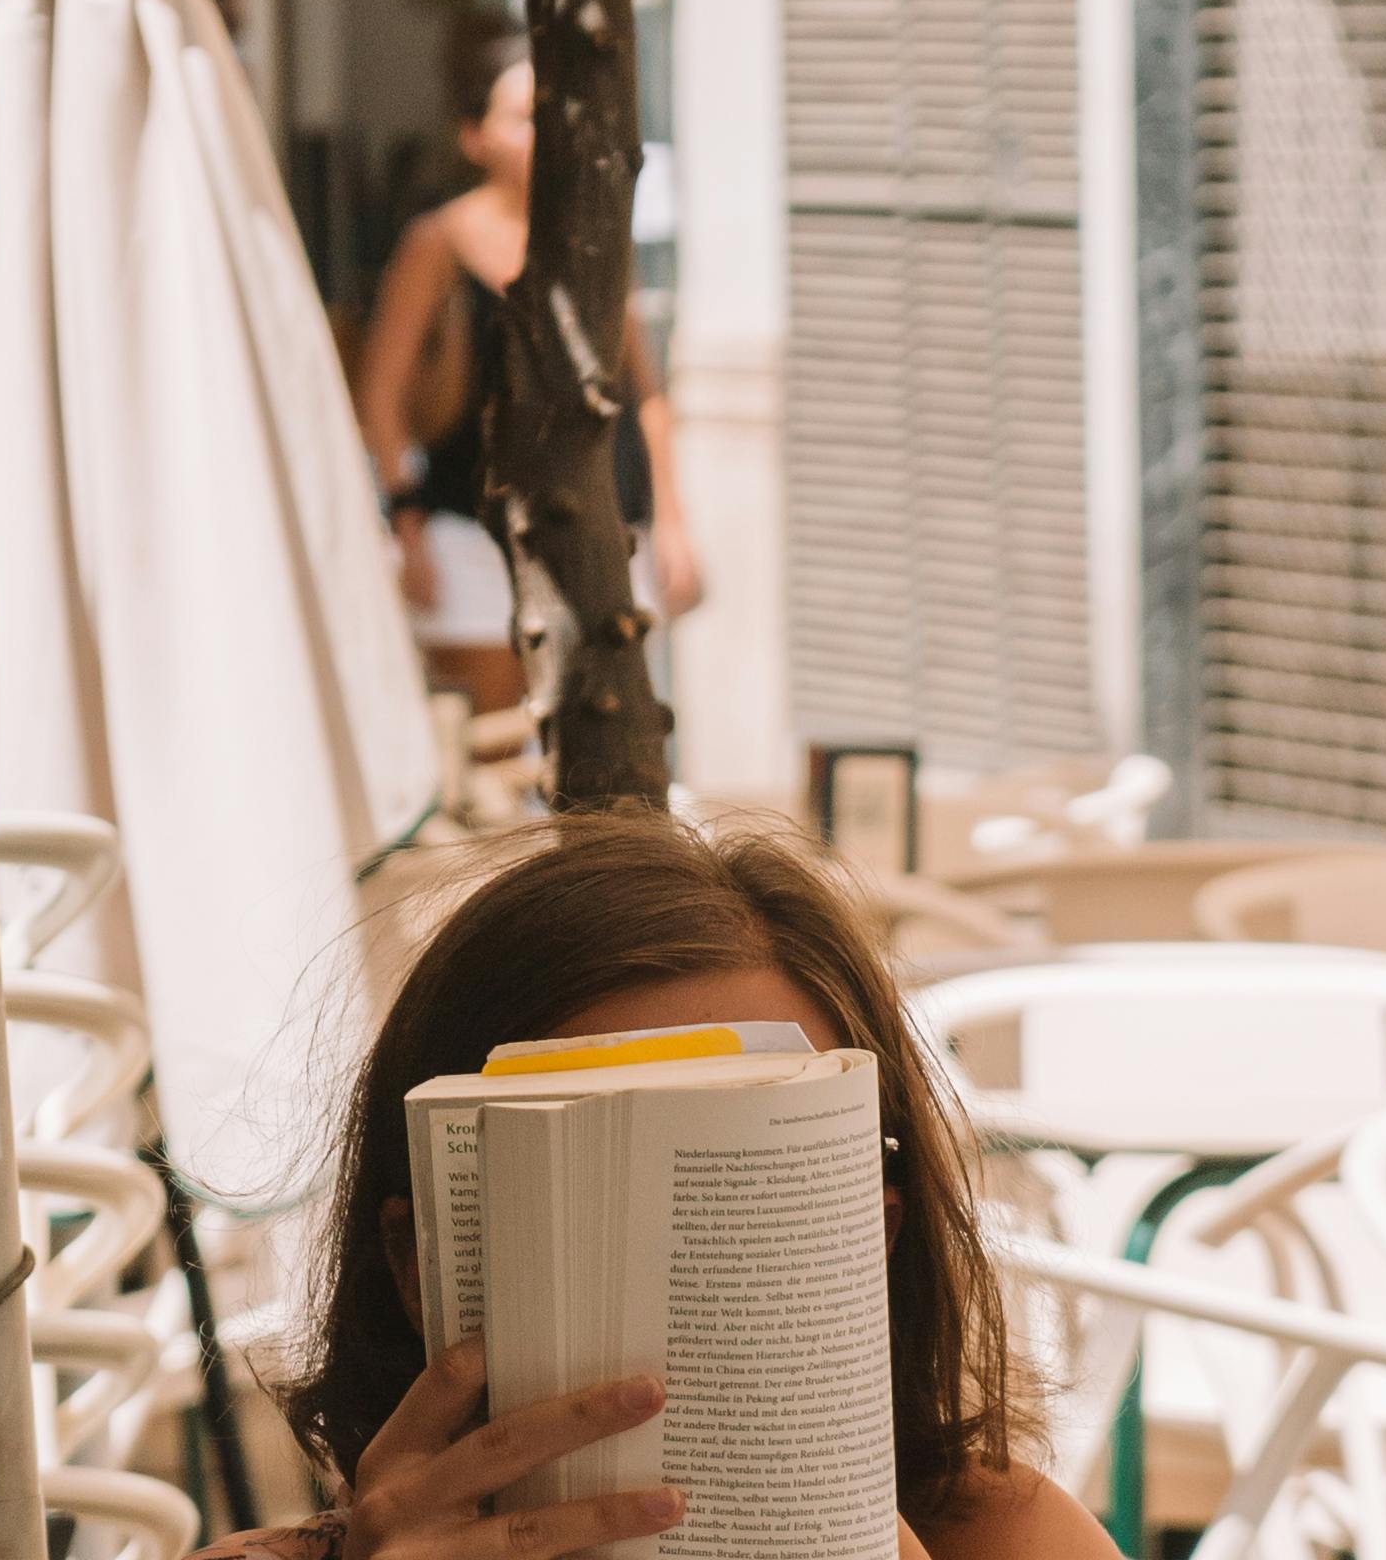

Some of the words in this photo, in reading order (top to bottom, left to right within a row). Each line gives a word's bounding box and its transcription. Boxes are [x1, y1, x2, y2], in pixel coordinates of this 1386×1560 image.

[675, 1148, 741, 1160] Niederlassung
[674, 1163, 723, 1173] finanzielle
[725, 1160, 805, 1172] Nachforschungen
[674, 1178, 689, 1187] auf
[689, 1178, 722, 1187] soziale
[723, 1177, 757, 1189] Signale
[701, 1193, 714, 1202] So
[714, 1192, 738, 1202] kann
[751, 1191, 777, 1200] sofort
[672, 1206, 688, 1216] der
[690, 1207, 709, 1216] sich
[726, 1208, 755, 1216] teures
[710, 1221, 726, 1231] der
[683, 1235, 737, 1245] Tatsächlich
[739, 1235, 772, 1246] spielen
[670, 1249, 687, 1259] der
[689, 1250, 743, 1262] Entstehung
[745, 1249, 780, 1259] sozialer
[670, 1263, 699, 1274] durch
[702, 1264, 752, 1274] erfundene
[756, 1261, 811, 1273] Hierarchien
[705, 1279, 741, 1289] Erstens
[746, 1279, 782, 1288] müssen
[669, 1293, 719, 1303] entwickelt
[765, 1292, 793, 1301] Selbst
[669, 1306, 698, 1316] Talent
[720, 1307, 742, 1317] Welt
[668, 1320, 691, 1330] ckelt
[723, 1322, 746, 1332] Aber
[749, 1322, 774, 1331] nicht
[668, 1335, 712, 1346] gefördert
[715, 1336, 738, 1346] wird
[740, 1336, 762, 1346] oder
[678, 1348, 694, 1359] der
[696, 1351, 753, 1360] erfundenen
[755, 1349, 804, 1360] Hierarchie
[666, 1361, 700, 1373] kommt
[715, 1365, 745, 1374] China
[747, 1367, 762, 1375] ein
[666, 1376, 681, 1386] der
[683, 1377, 717, 1388] Geburt
[665, 1392, 730, 1402] mannsfamilie
[745, 1394, 778, 1405] Peking
[665, 1405, 680, 1414] auf
[682, 1405, 704, 1416] dem
[706, 1407, 736, 1417] Markt
[739, 1408, 759, 1418] und
[664, 1418, 681, 1428] Der
[683, 1420, 716, 1430] andere
[717, 1421, 750, 1432] Bruder
[753, 1422, 785, 1432] wächst
[664, 1432, 698, 1443] Bauern
[721, 1436, 737, 1445] die
[740, 1436, 765, 1446] nicht
[663, 1448, 687, 1457] seine
[689, 1448, 708, 1458] Zeit
[709, 1450, 725, 1459] auf
[726, 1450, 748, 1460] dem
[662, 1461, 687, 1470] Gene
[725, 1465, 761, 1474] werden
[662, 1474, 706, 1486] dieselben
[709, 1477, 764, 1489] Fähigkeiten
[742, 1494, 768, 1503] selbst
[709, 1506, 755, 1517] dieselben
[759, 1508, 815, 1519] Fähigkeiten
[687, 1519, 727, 1529] dieselbe
[731, 1521, 771, 1531] Aussicht
[659, 1532, 685, 1541] exakt
[687, 1533, 728, 1544] dasselbe
[731, 1535, 817, 1545] unternehmerische
